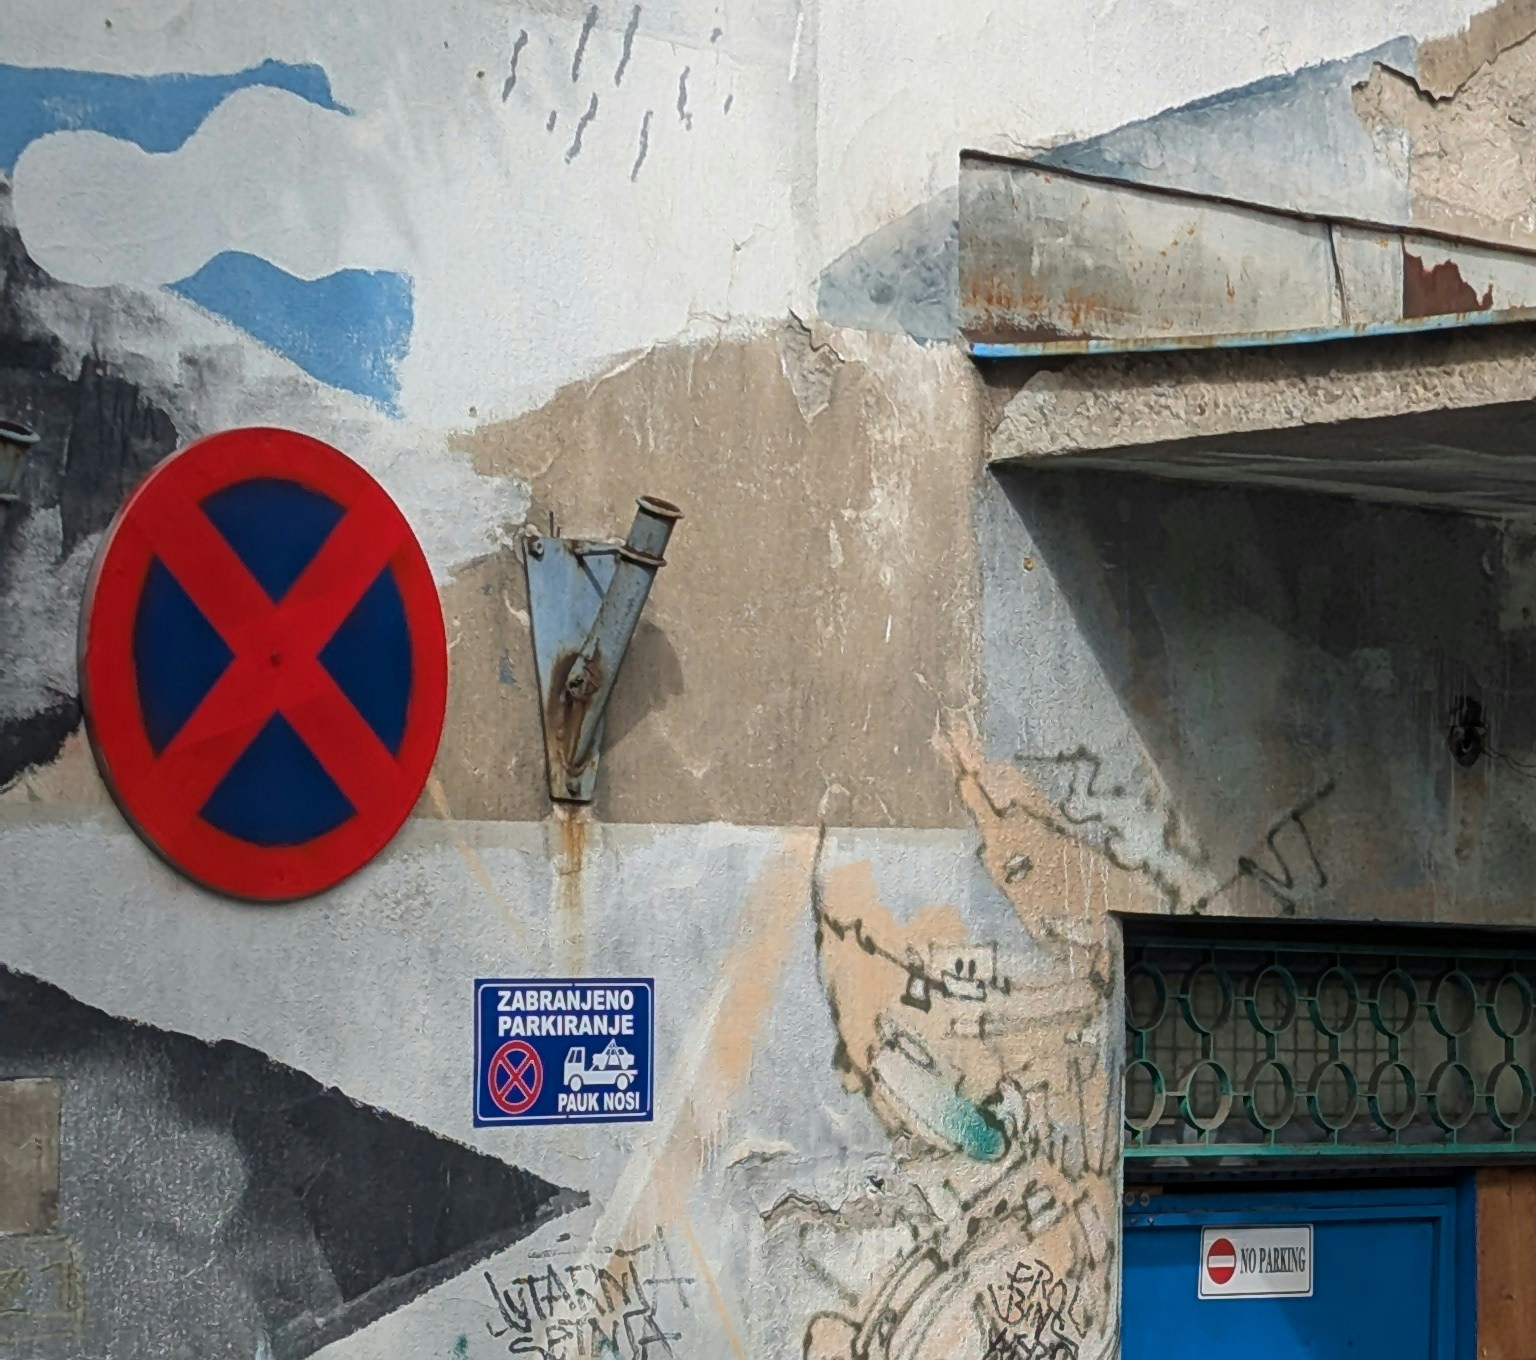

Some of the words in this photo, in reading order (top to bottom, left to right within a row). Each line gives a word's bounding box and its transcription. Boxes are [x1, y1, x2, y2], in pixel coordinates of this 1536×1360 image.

[497, 990, 634, 1011] ZABRANJENO
[497, 1015, 634, 1037] PARKIRANJE
[557, 1092, 600, 1112] PAUK
[603, 1091, 641, 1111] NOSI
[1239, 1247, 1257, 1274] NO
[1258, 1246, 1306, 1273] PARKING
